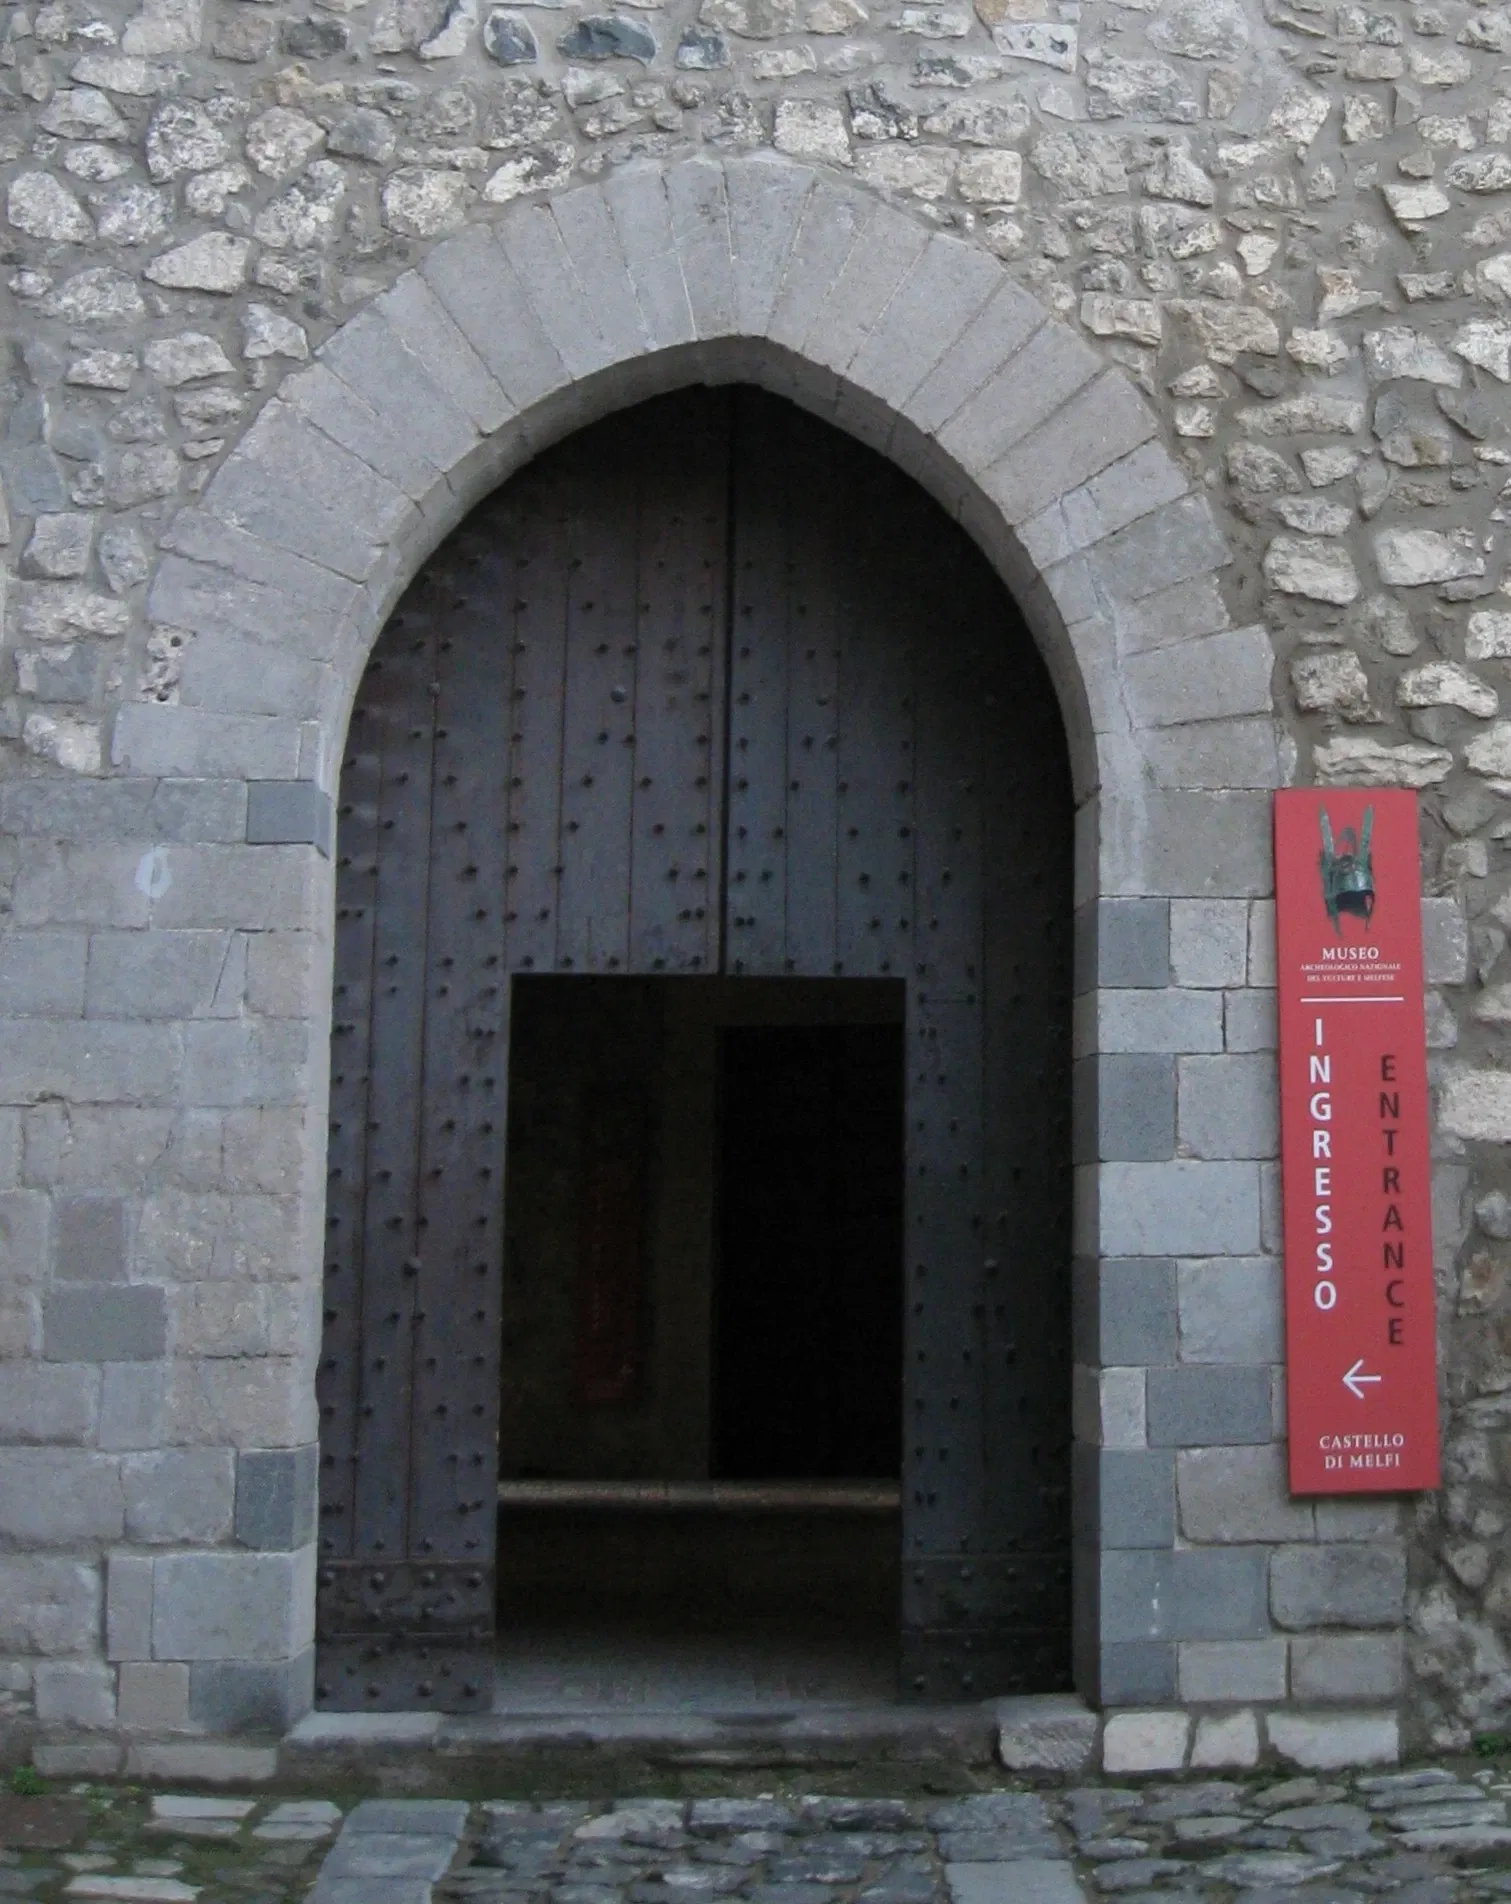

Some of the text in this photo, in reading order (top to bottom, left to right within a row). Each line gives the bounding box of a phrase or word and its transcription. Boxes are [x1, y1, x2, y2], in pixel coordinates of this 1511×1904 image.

[1322, 946, 1380, 961] MUSEO
[1309, 1018, 1337, 1310] INGRESSO
[1378, 1053, 1406, 1347] ENTRANCE
[1318, 1432, 1405, 1450] CASTELLO
[1324, 1452, 1401, 1469] DI MELFI
